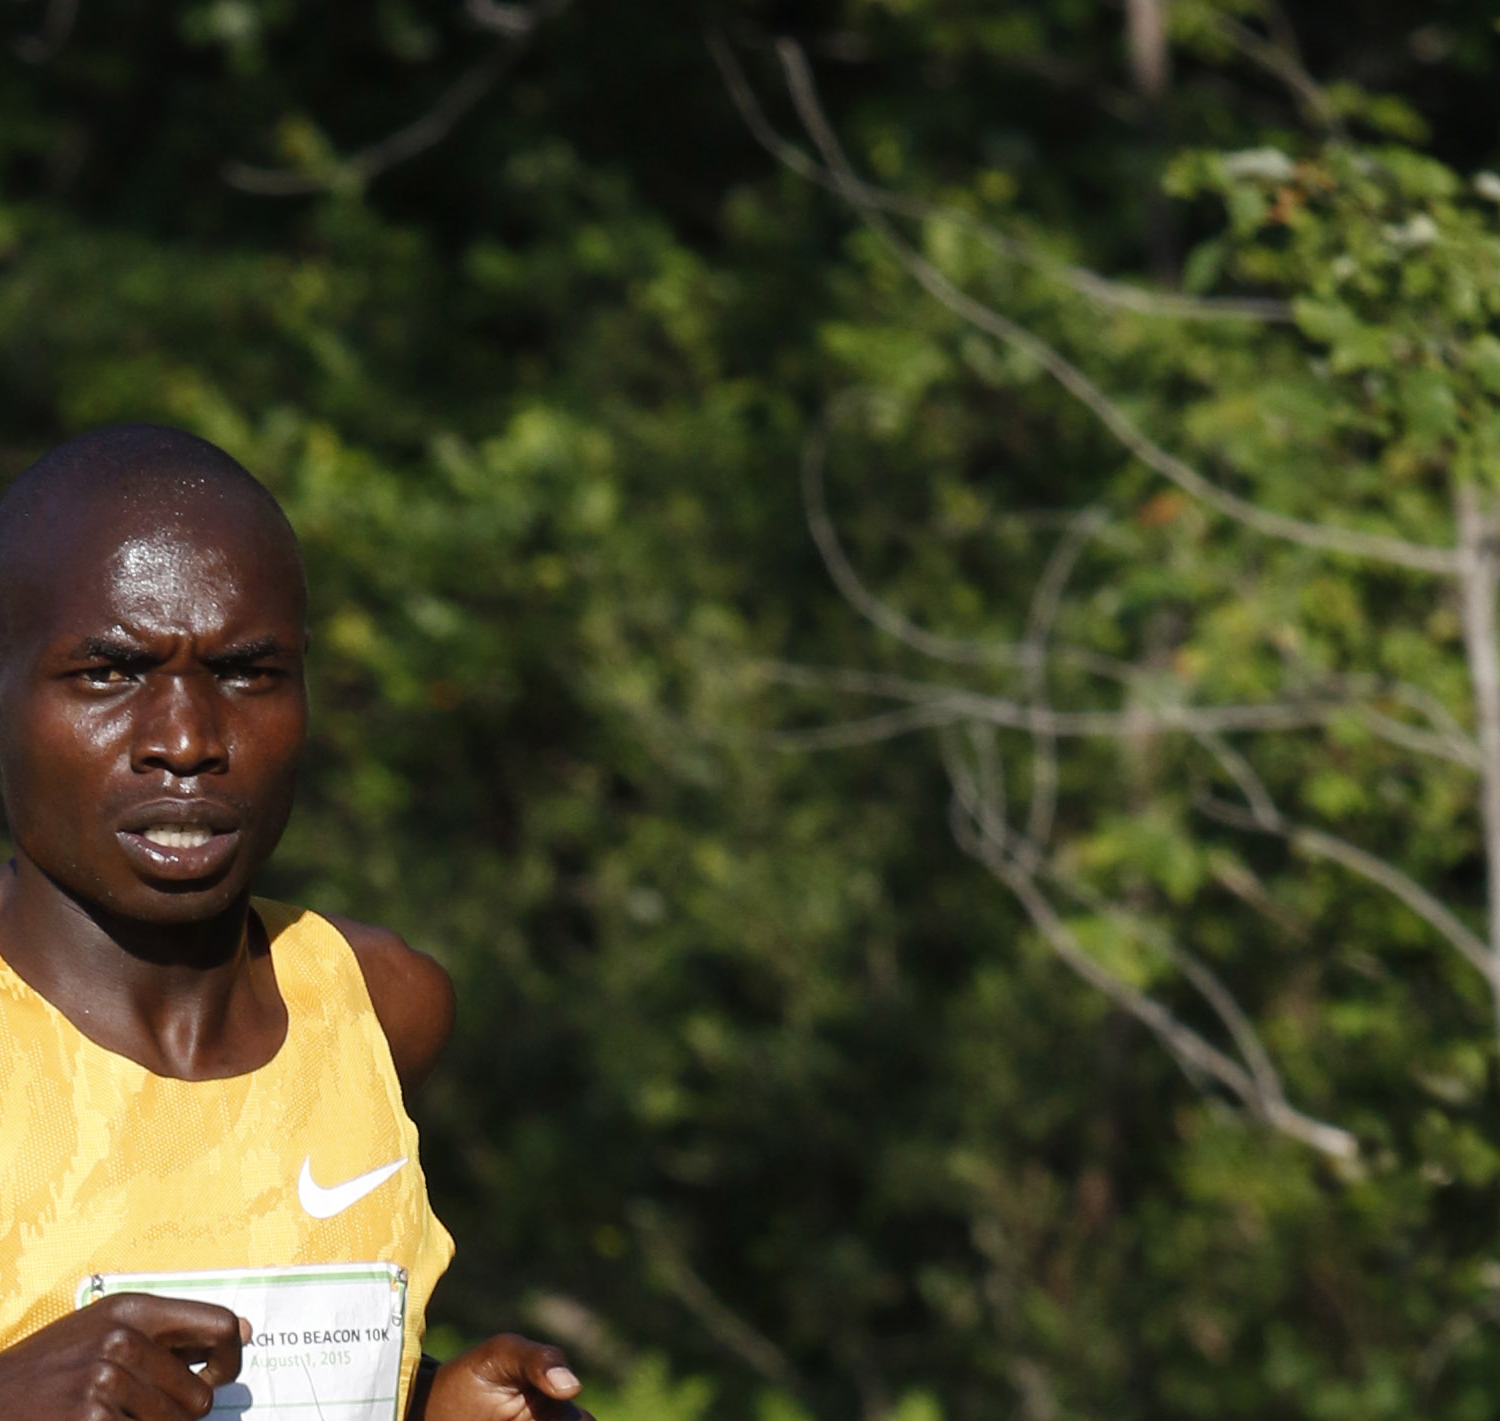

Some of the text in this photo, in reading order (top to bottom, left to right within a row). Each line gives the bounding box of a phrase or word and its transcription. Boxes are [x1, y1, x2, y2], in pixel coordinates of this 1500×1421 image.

[280, 1332, 298, 1345] TO
[303, 1329, 361, 1344] BEACON
[366, 1327, 390, 1342] 10K
[251, 1354, 300, 1372] August
[320, 1351, 352, 1366] 2015
